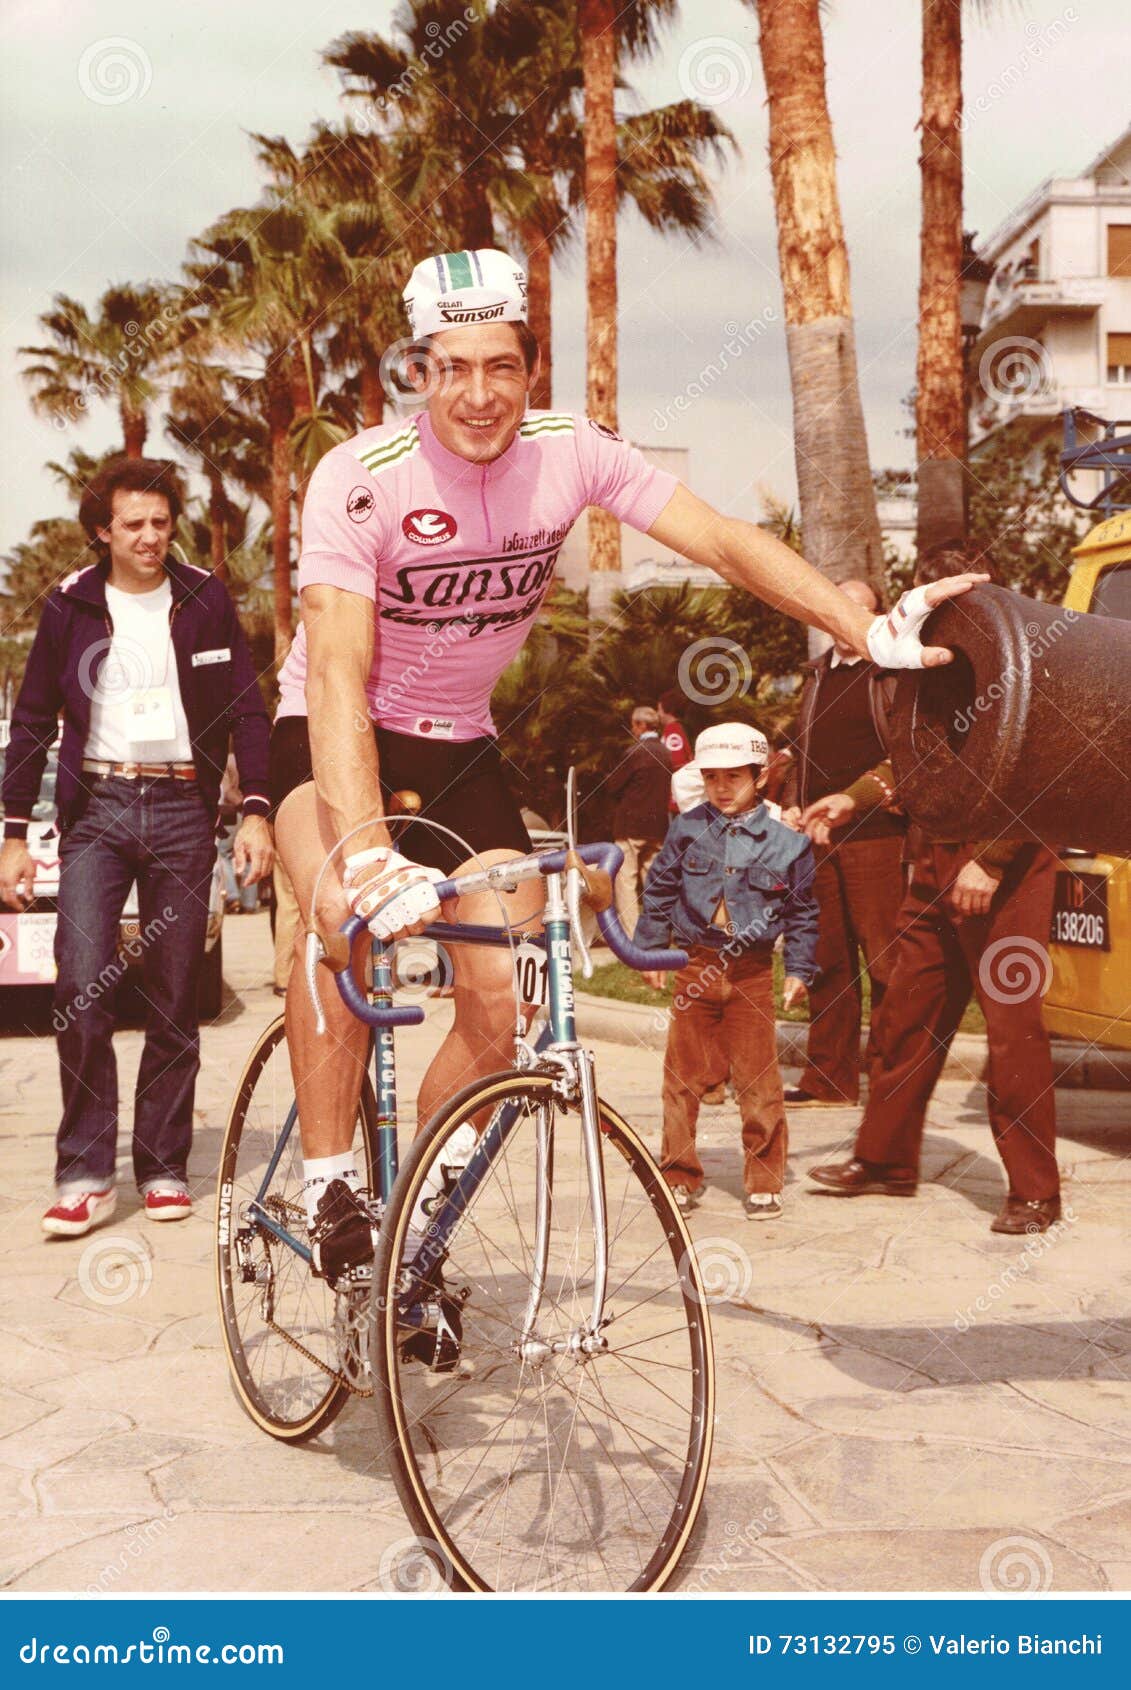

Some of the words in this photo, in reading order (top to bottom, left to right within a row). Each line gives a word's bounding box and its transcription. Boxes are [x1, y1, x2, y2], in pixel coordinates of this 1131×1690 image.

[437, 301, 463, 309] GELATI
[440, 301, 508, 323] Sanson
[408, 532, 451, 545] COLUMBUS
[380, 543, 562, 607] Sanson
[1056, 911, 1104, 945] 138206
[551, 939, 575, 1024] moser
[380, 1032, 397, 1101] oser
[218, 1183, 233, 1246] MAVIC
